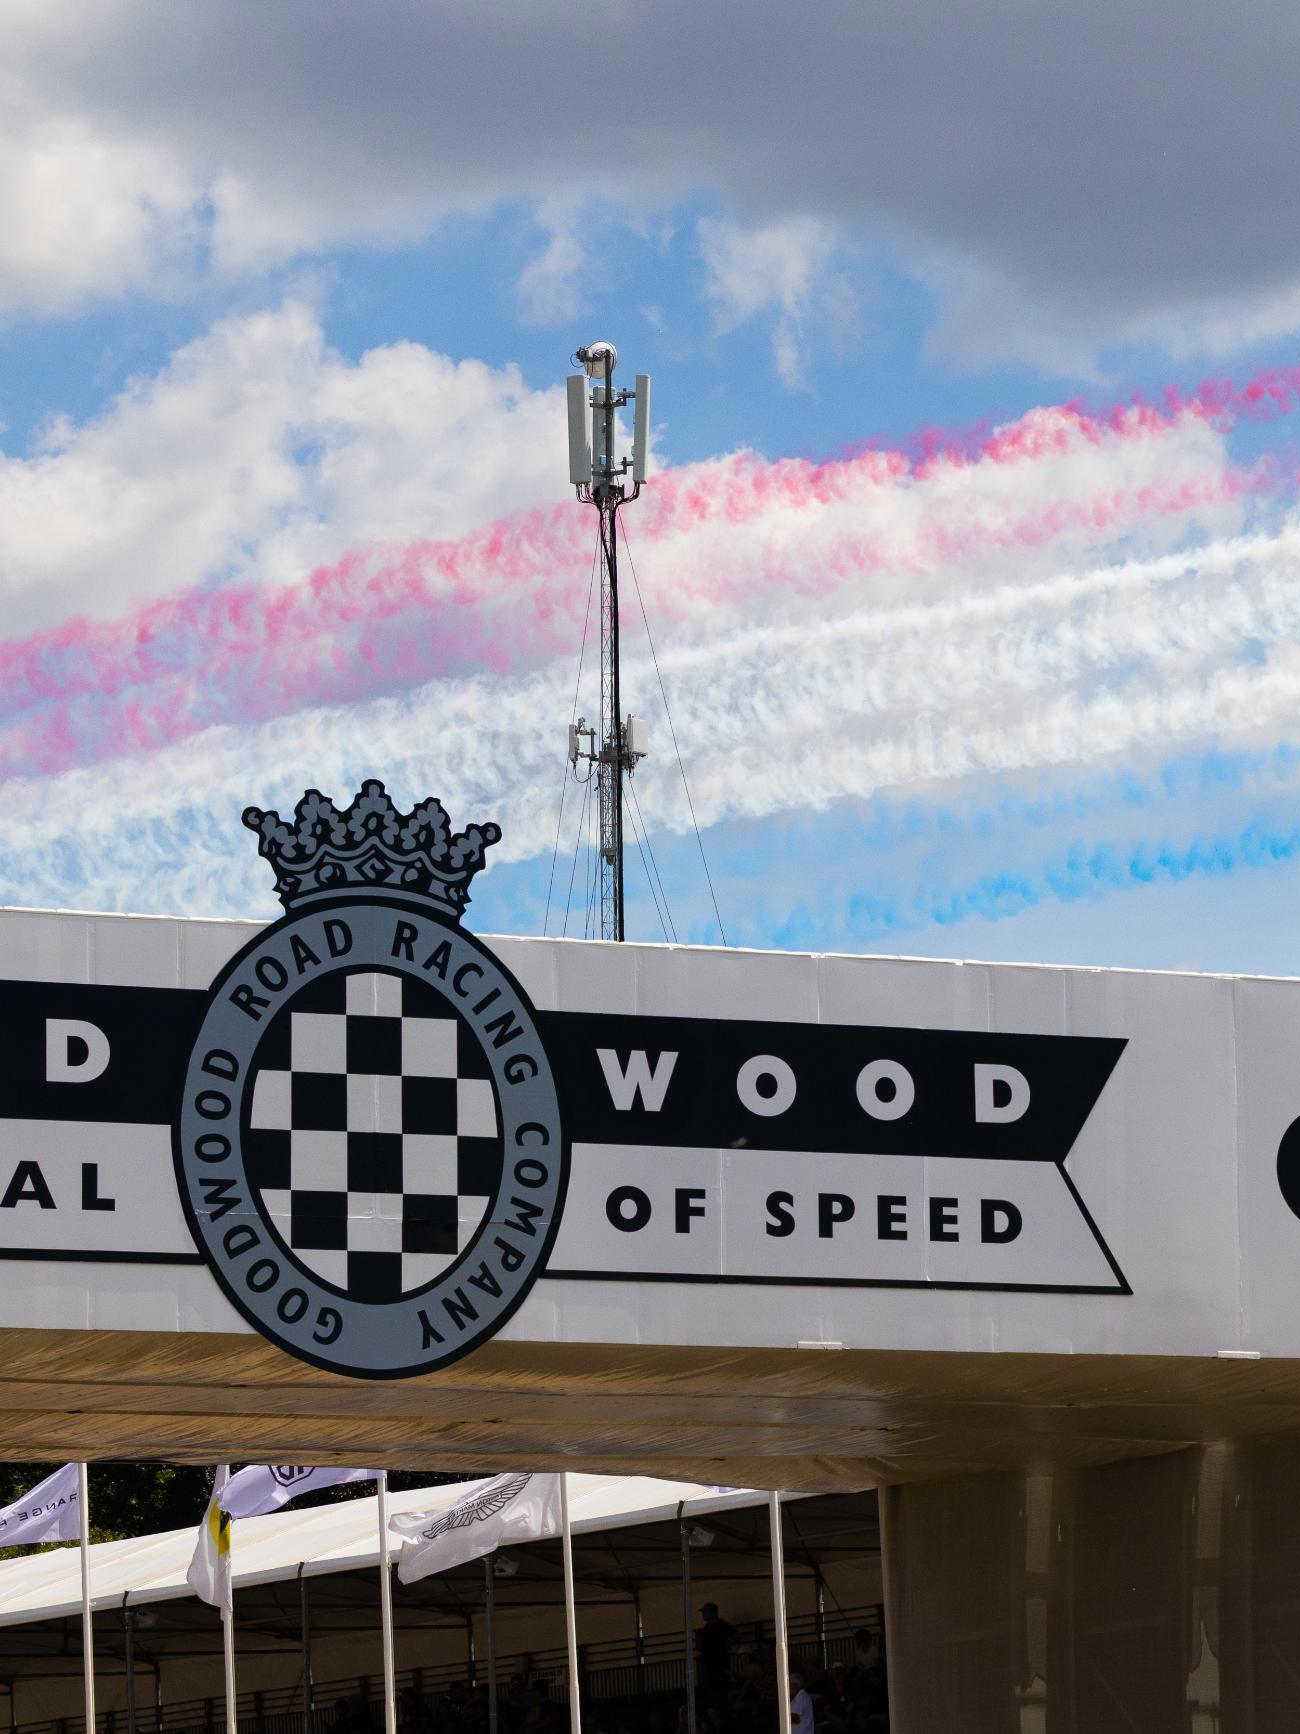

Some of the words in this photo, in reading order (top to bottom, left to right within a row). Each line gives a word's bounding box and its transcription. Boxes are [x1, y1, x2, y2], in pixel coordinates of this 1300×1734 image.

[229, 917, 353, 1021] ROAD
[391, 919, 539, 1087] RACING
[596, 1048, 1031, 1124] WOOD
[194, 1047, 344, 1346] GOODWOOD
[417, 1121, 550, 1350] COMPANY
[605, 1185, 707, 1234] OF
[765, 1190, 1023, 1244] SPEED
